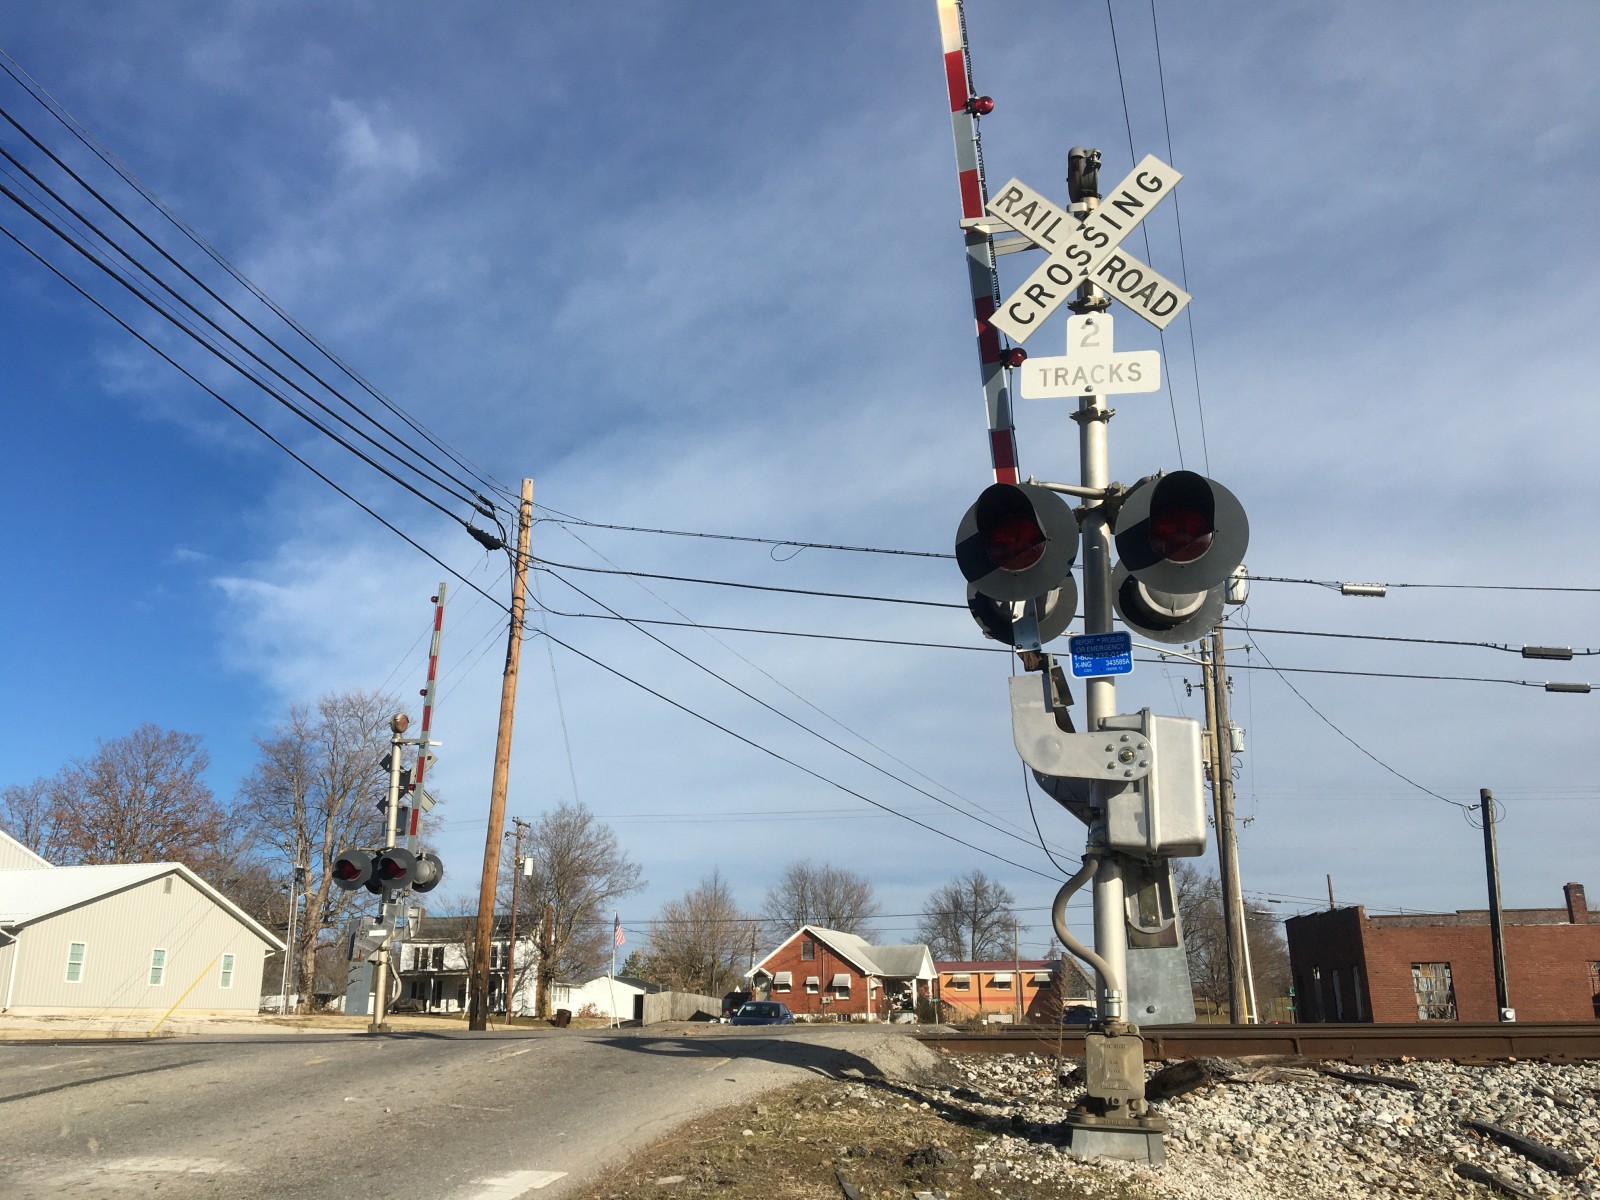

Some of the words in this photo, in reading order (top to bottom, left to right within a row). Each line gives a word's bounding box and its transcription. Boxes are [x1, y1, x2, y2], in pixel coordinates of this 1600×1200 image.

[995, 186, 1063, 245] RAIL
[1096, 254, 1178, 318] ROAD
[1008, 171, 1163, 325] CROSSING
[1079, 321, 1100, 348] 2
[1038, 361, 1143, 388] TRACKS
[1086, 643, 1125, 652] EMERGENCY
[1075, 661, 1092, 669] X-ING
